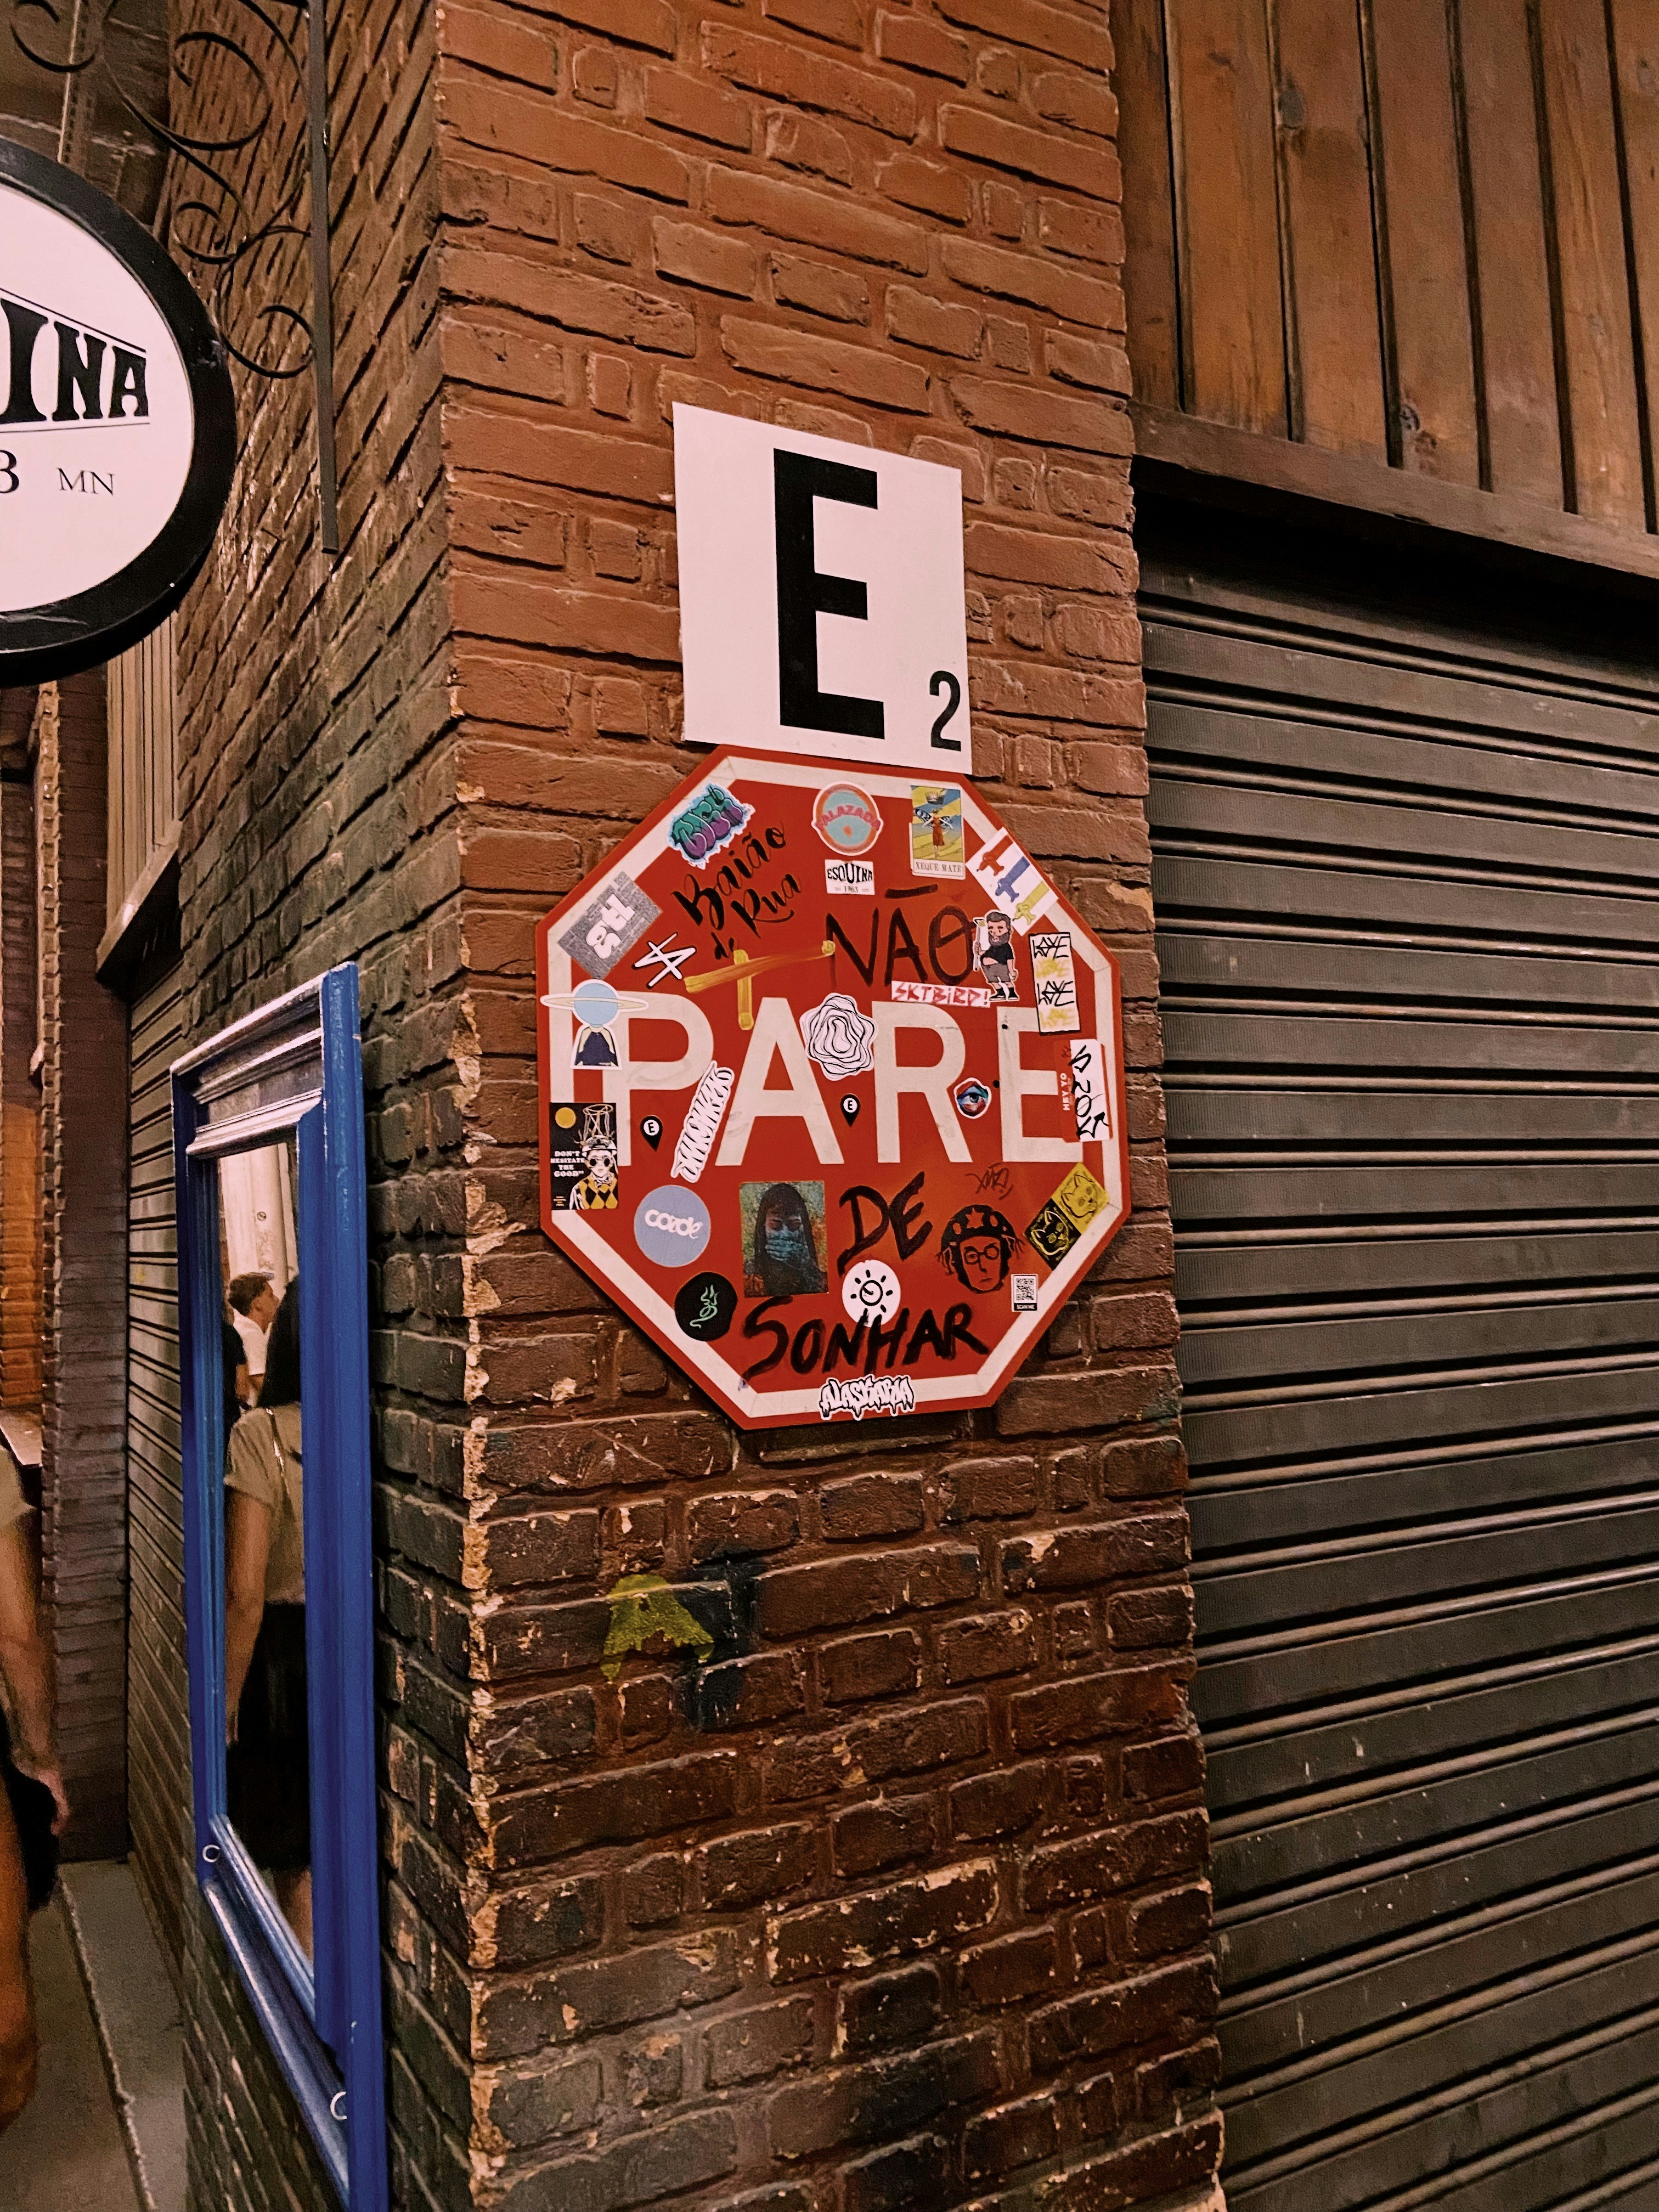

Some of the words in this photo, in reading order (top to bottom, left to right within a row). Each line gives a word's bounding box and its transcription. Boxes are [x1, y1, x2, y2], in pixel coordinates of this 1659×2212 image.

[57, 467, 115, 496] MN
[774, 448, 885, 740] E
[929, 670, 962, 752] 2
[671, 821, 787, 931] Baião
[827, 862, 873, 884] ESQUINA
[916, 862, 939, 871] XEQUE
[941, 864, 962, 872] MATE
[731, 873, 802, 939] Rua
[602, 990, 1084, 1167] PARE
[1060, 1073, 1068, 1090] YO
[1062, 1090, 1070, 1111] HEY
[648, 1122, 655, 1133] E
[848, 1100, 853, 1110] E
[837, 1171, 933, 1277] DE
[742, 1296, 992, 1383] SONHAR
